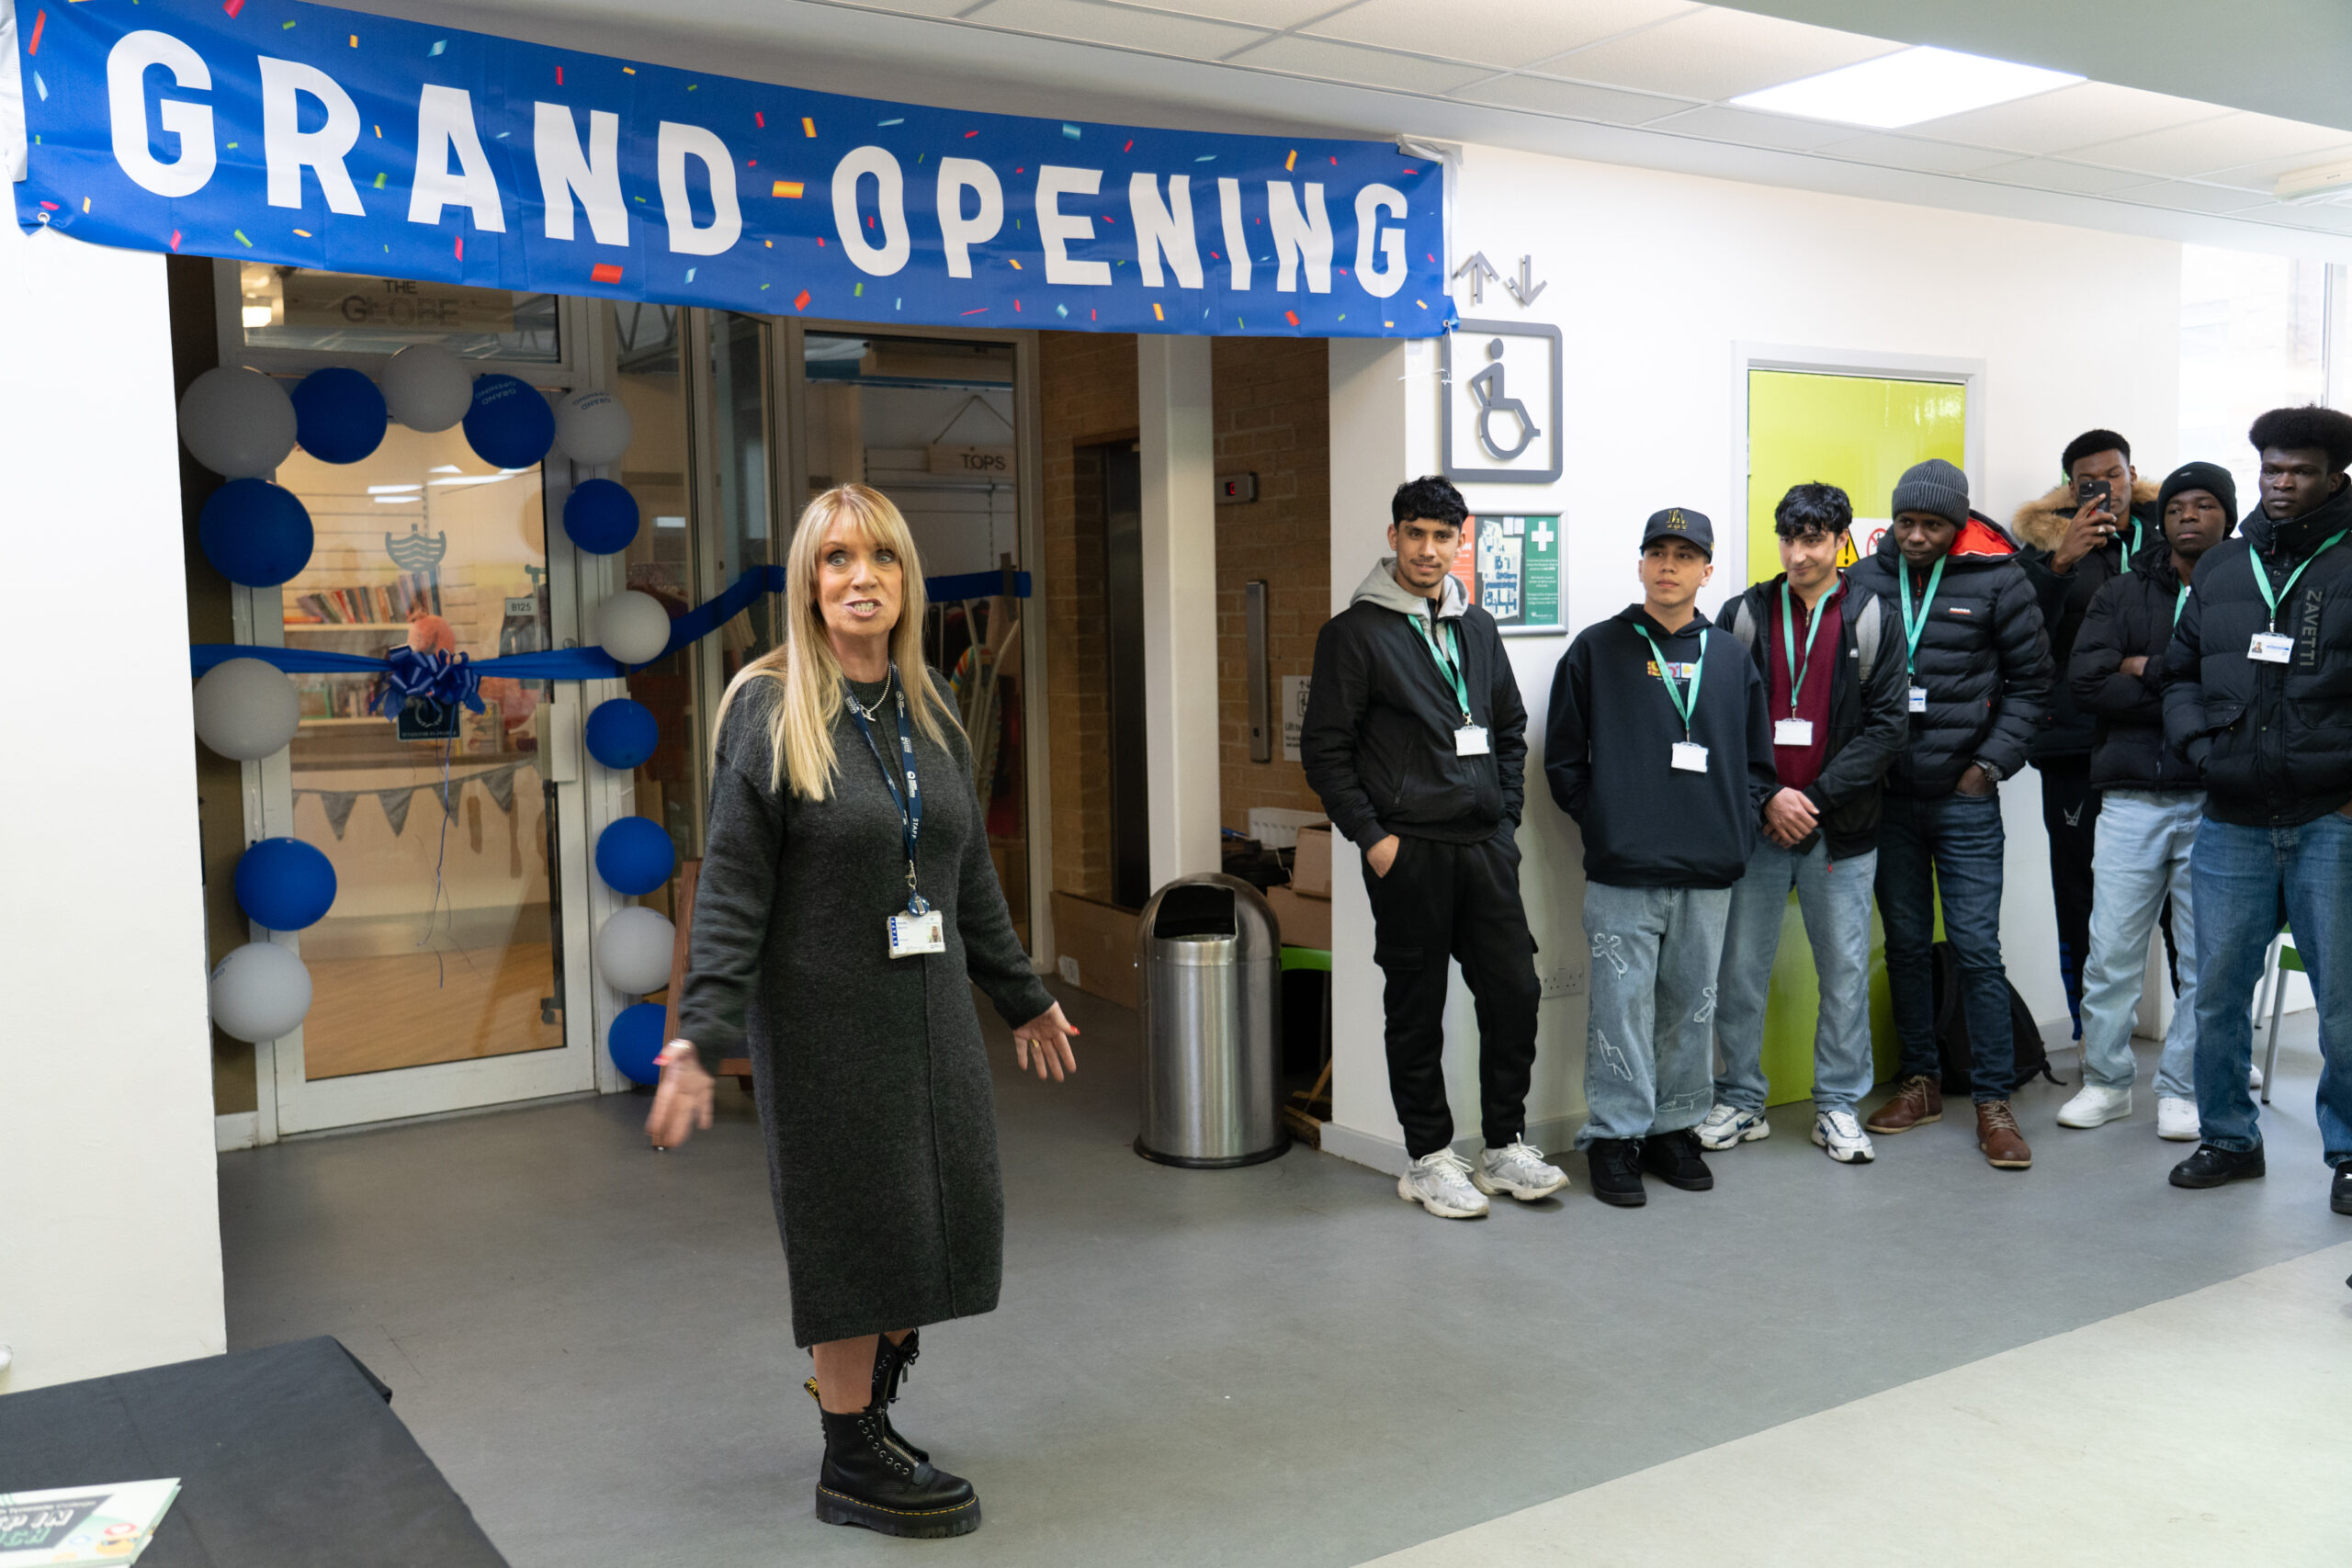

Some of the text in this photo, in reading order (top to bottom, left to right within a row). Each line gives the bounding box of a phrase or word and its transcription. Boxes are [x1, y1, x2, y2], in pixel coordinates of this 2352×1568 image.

[107, 29, 1408, 299] GRAND OPENING
[382, 279, 418, 295] THE
[341, 295, 460, 326] GLOBE
[481, 389, 516, 405] GRAND
[960, 454, 1007, 470] TOPS
[511, 602, 532, 612] B125
[2299, 590, 2323, 666] ZAVETTI
[911, 818, 920, 840] STAFF
